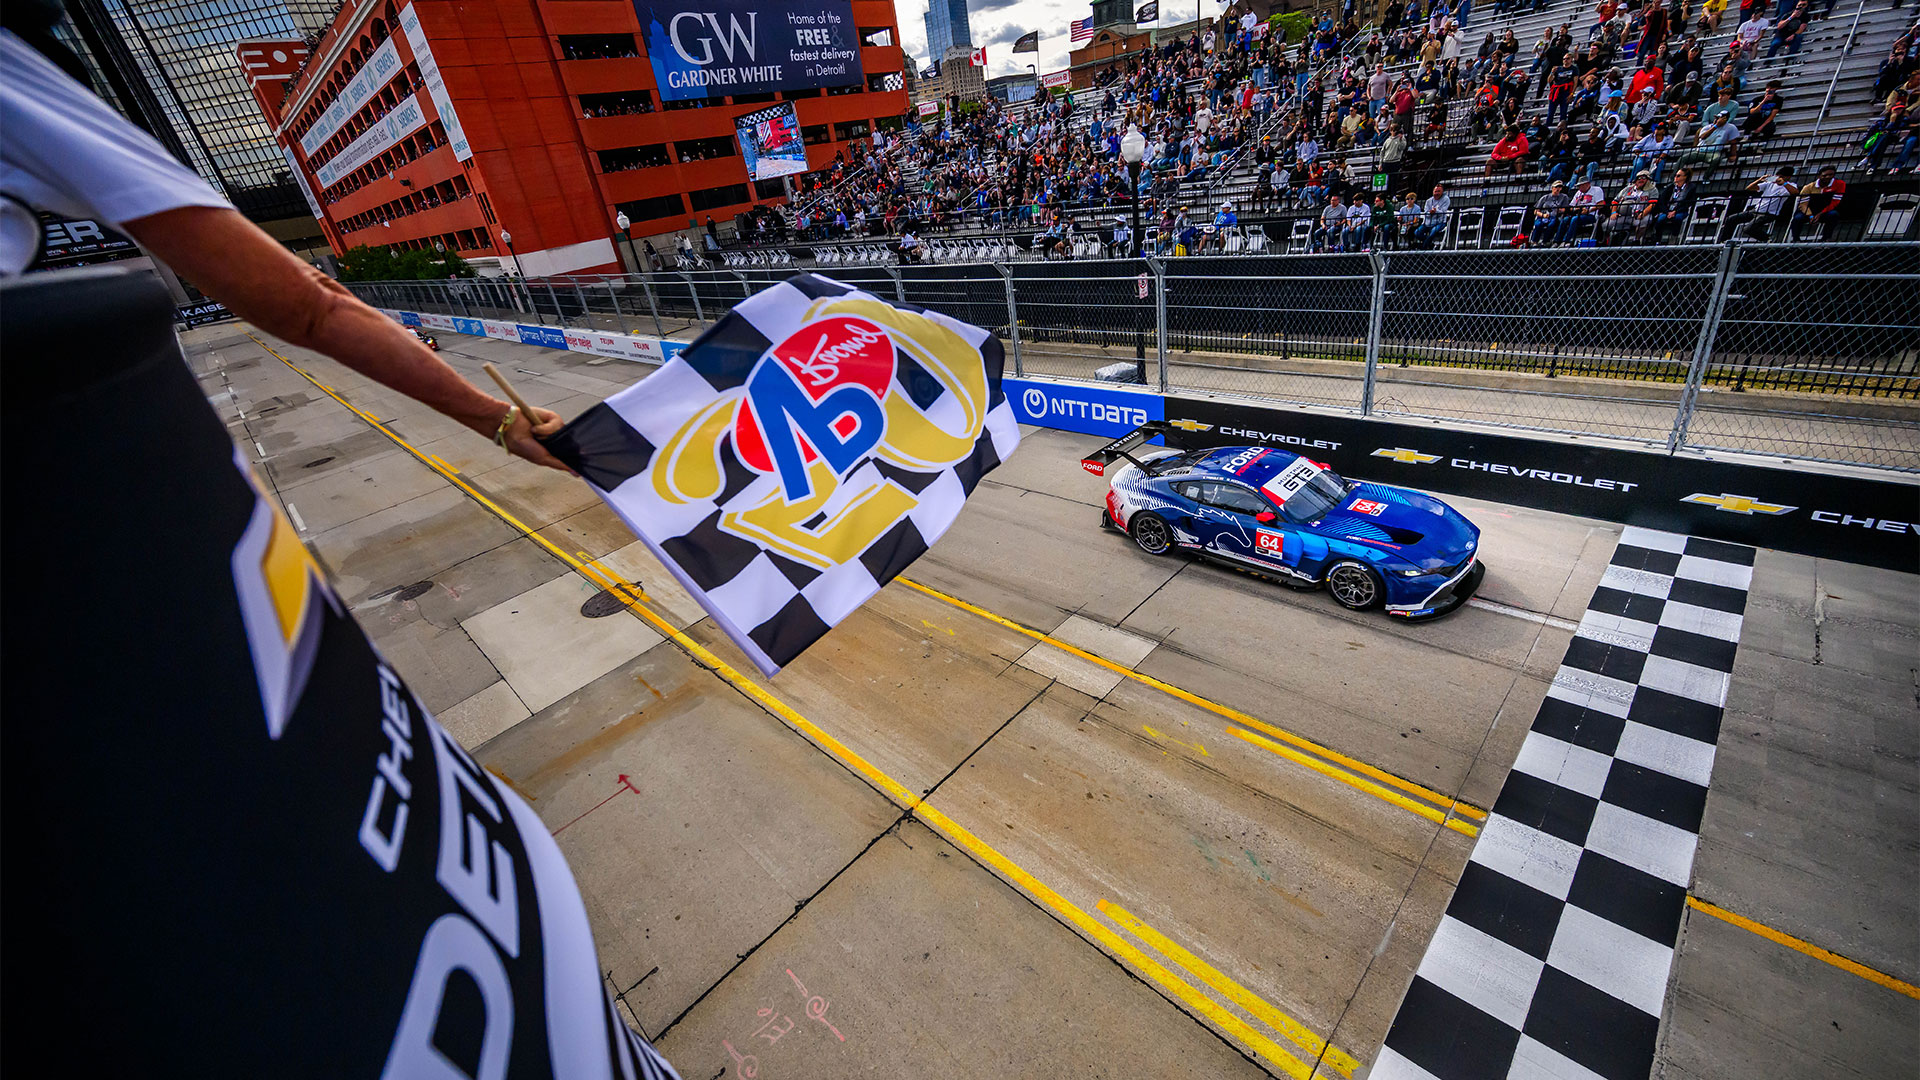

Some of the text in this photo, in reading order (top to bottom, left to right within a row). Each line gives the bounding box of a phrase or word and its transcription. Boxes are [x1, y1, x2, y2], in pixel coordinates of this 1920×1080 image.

[787, 10, 841, 24] Home of the
[669, 12, 758, 65] GW
[796, 28, 831, 46] FREE
[790, 47, 856, 62] fastest delivery
[668, 65, 783, 89] GARDNER WHITE
[805, 62, 846, 77] in Detroit!
[1045, 75, 1062, 86] Section
[1051, 398, 1089, 418] NTT
[1219, 426, 1342, 451] CHEVROLET
[1082, 462, 1103, 472] FORD
[1222, 446, 1265, 474] FORD
[1283, 466, 1315, 492] GT3
[1451, 457, 1638, 494] CHEVROLET
[1260, 535, 1279, 550] 64
[381, 708, 520, 1080] DET
